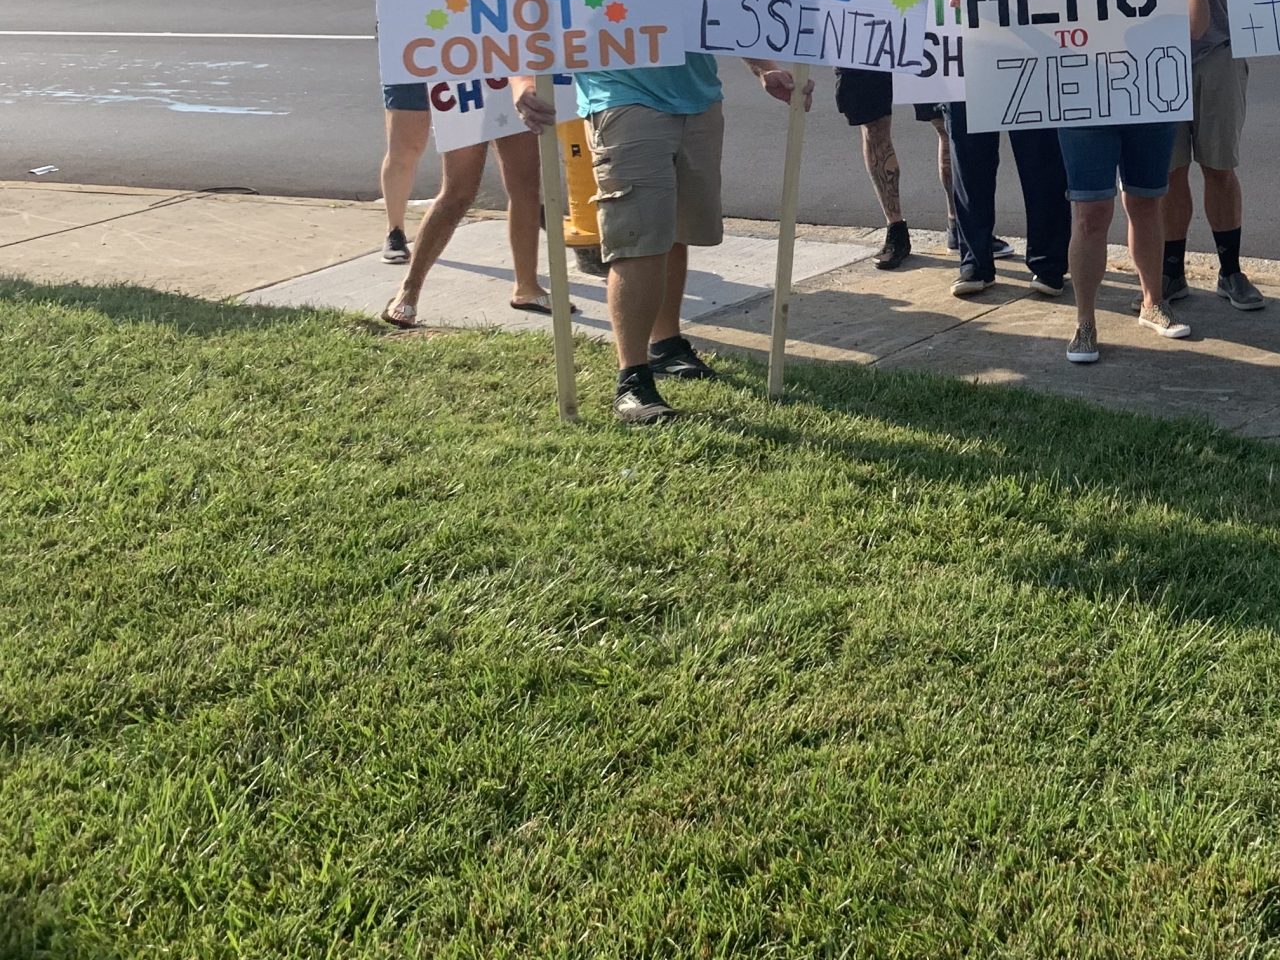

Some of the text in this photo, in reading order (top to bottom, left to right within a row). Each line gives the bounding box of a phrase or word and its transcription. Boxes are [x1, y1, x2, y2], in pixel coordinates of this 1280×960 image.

[402, 25, 668, 77] CONSENT
[1055, 28, 1089, 48] TO
[997, 46, 1189, 125] ZERO
